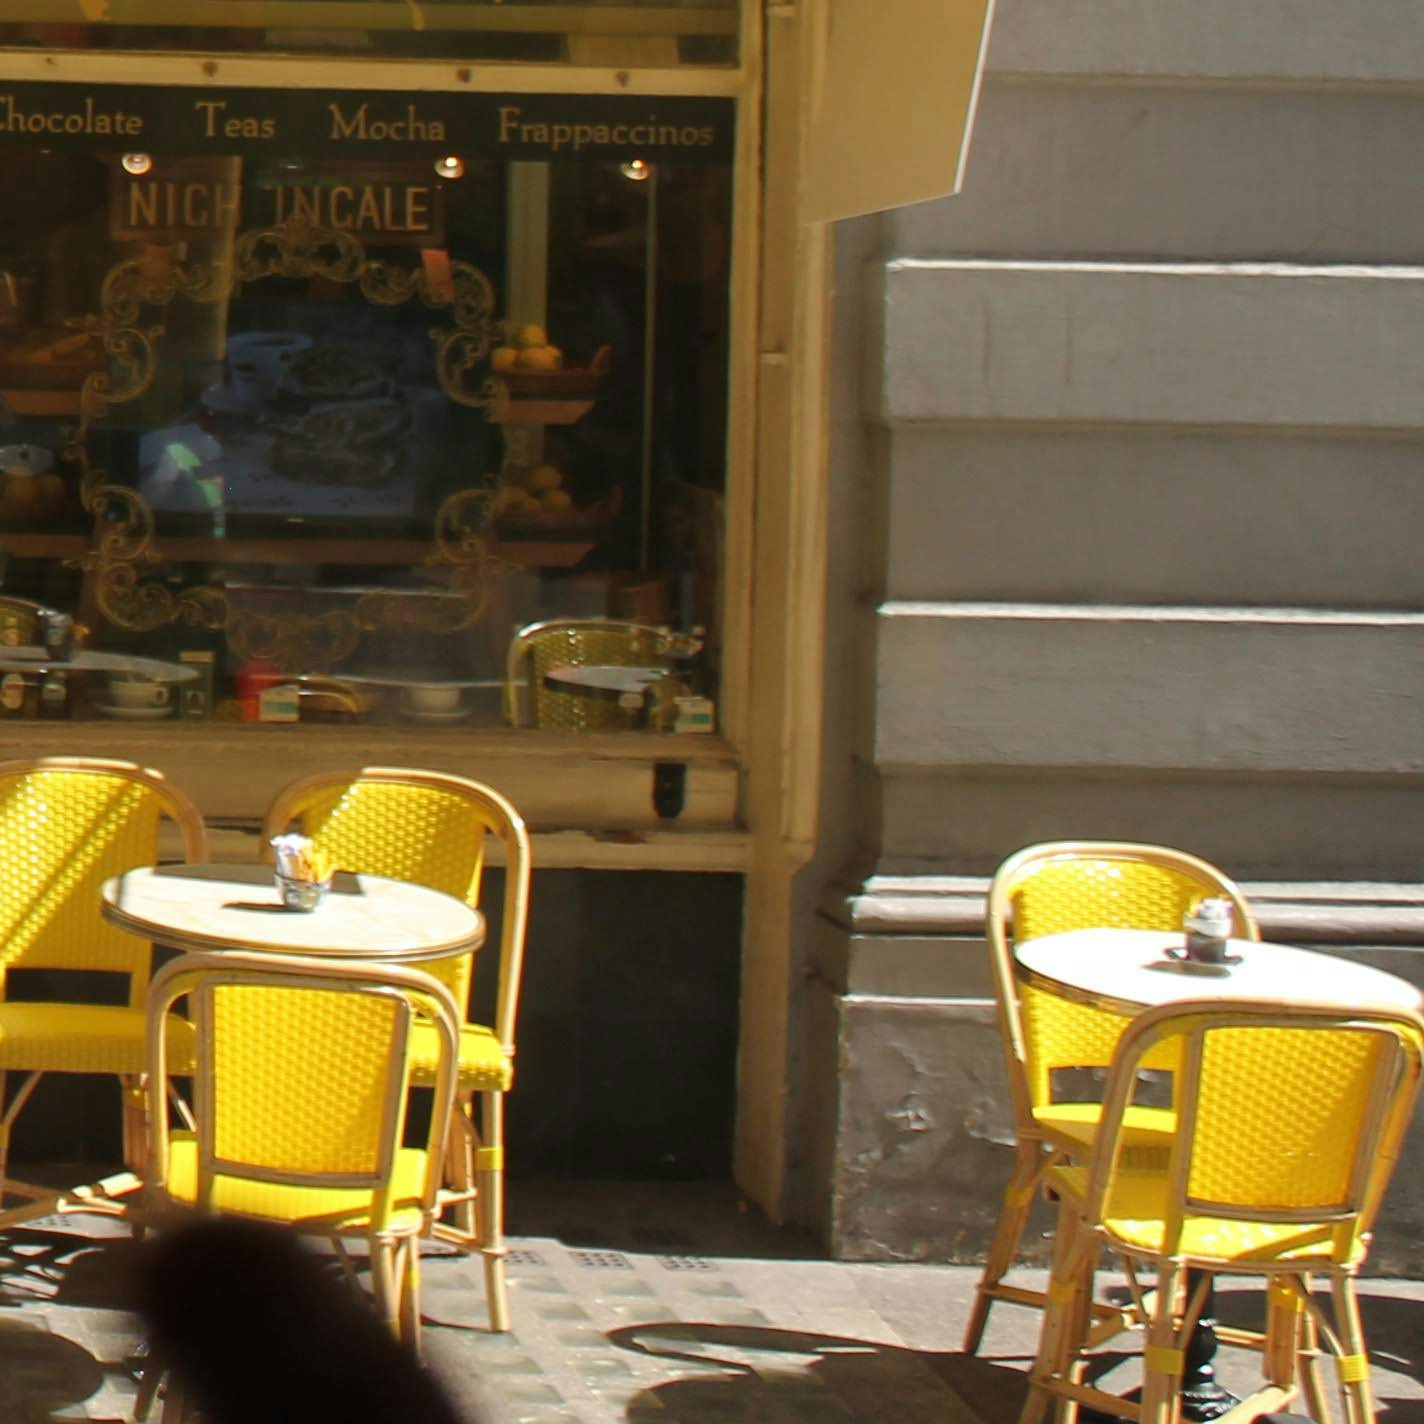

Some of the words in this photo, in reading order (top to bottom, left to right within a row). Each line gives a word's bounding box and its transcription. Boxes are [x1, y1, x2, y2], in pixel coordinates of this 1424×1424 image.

[195, 100, 276, 140] Teas
[329, 104, 447, 143] Mocha
[498, 106, 714, 154] Frappaccinos
[128, 180, 430, 232] NIGHINGALE
